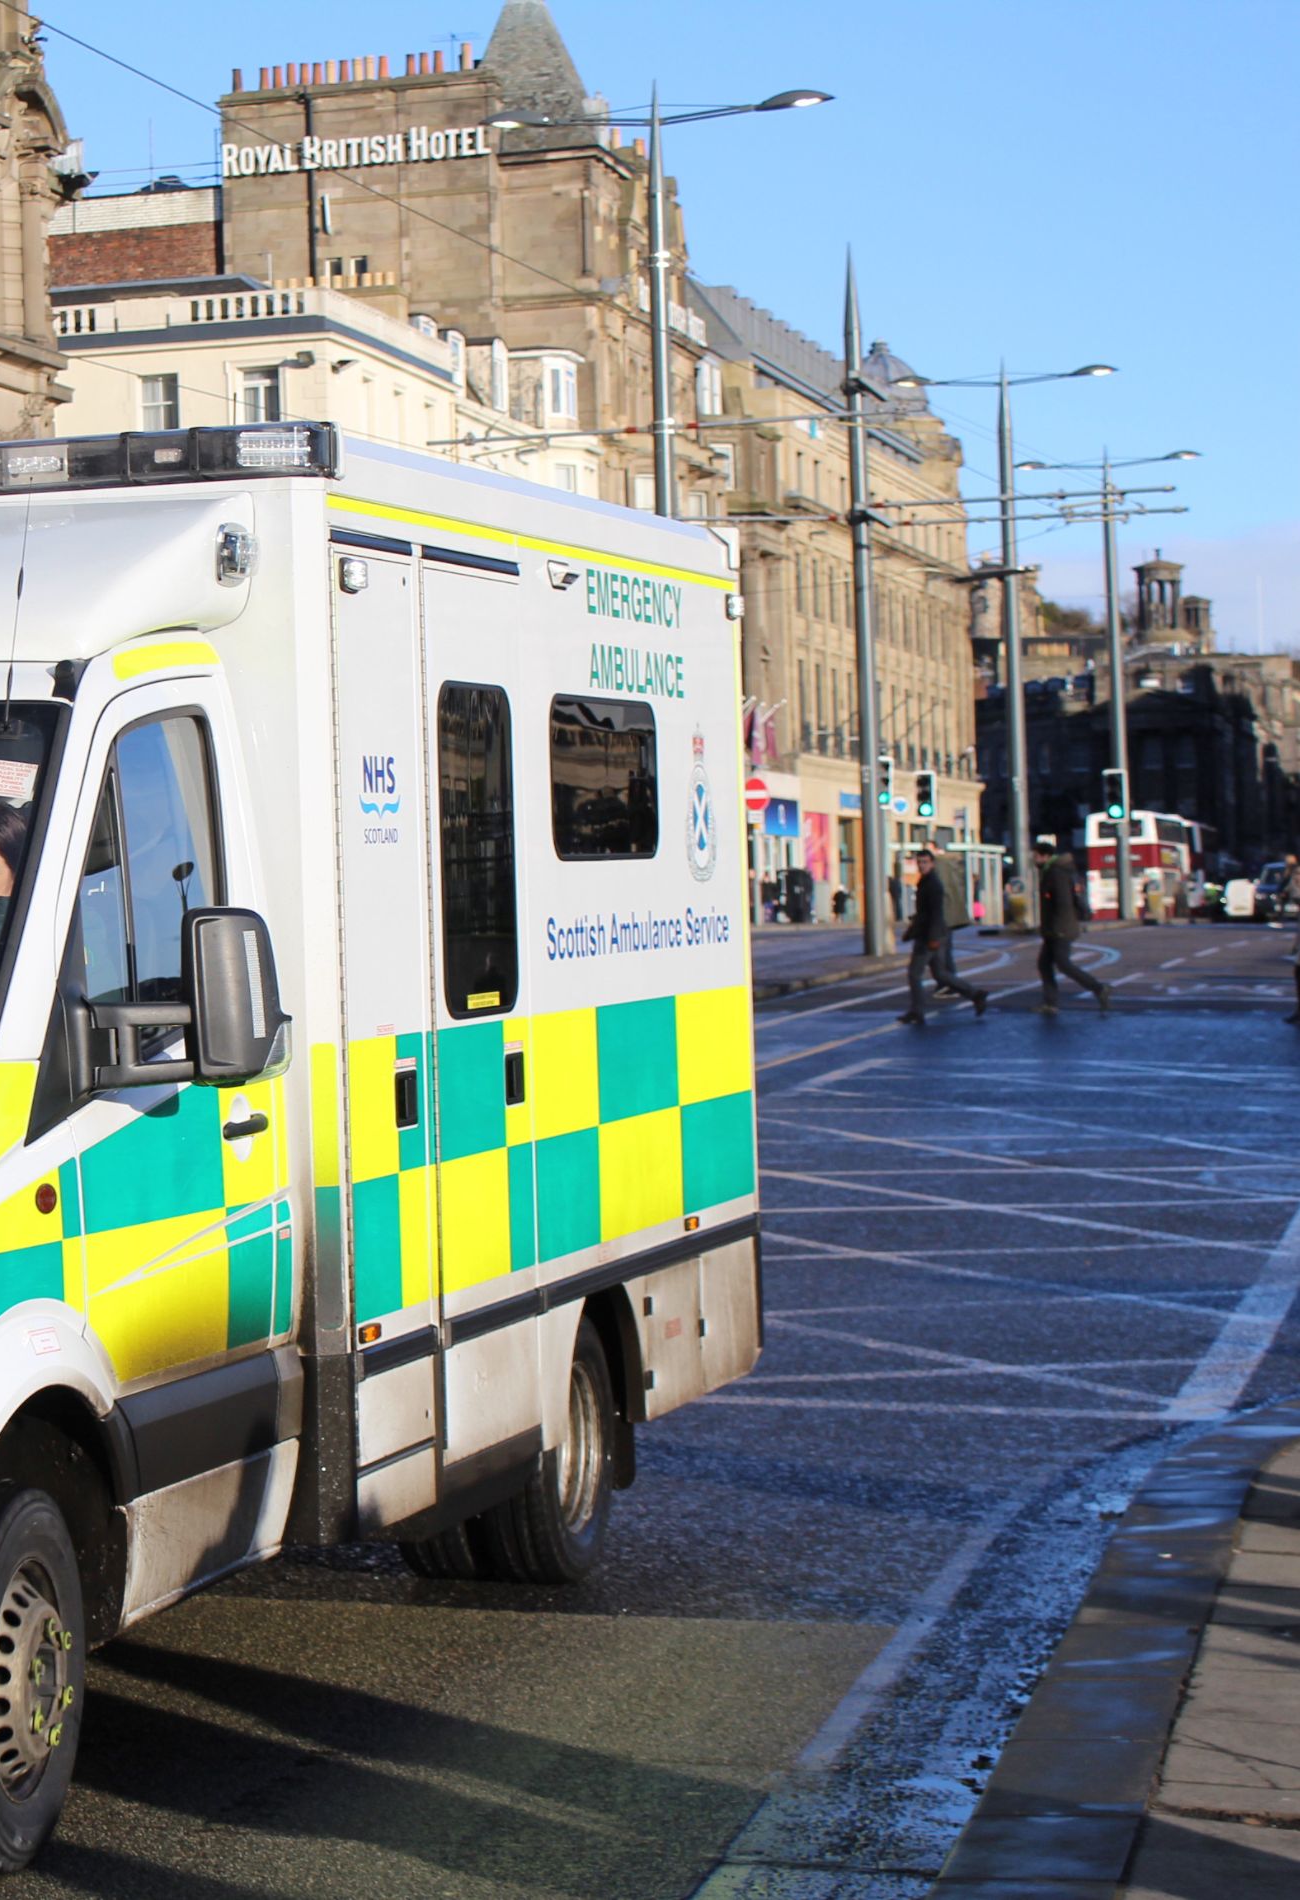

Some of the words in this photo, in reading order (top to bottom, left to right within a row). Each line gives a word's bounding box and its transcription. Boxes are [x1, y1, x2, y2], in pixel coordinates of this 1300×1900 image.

[586, 568, 682, 629] EMERGENCY
[589, 642, 685, 699] AMBULANCE
[362, 755, 396, 794] NHS
[363, 827, 399, 845] SCOTLAND
[546, 914, 607, 961] Scottish
[609, 910, 683, 954] Ambulance
[685, 905, 730, 947] Service
